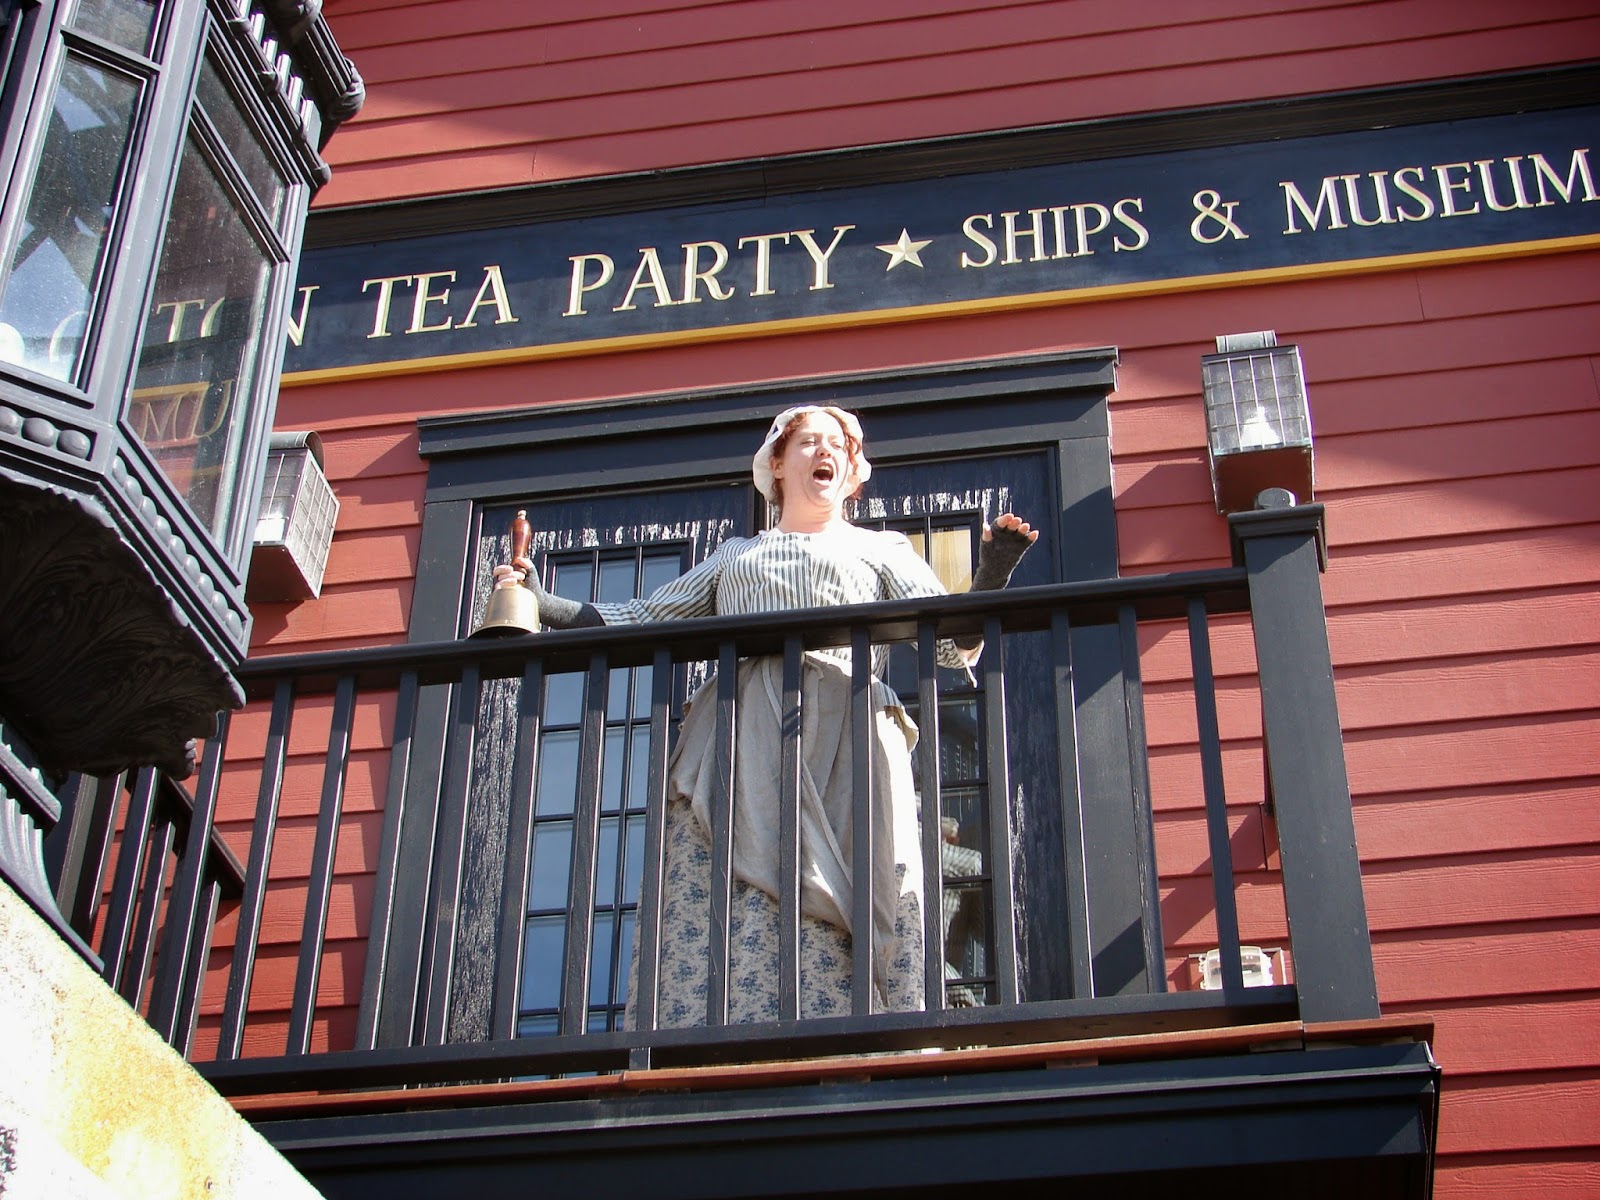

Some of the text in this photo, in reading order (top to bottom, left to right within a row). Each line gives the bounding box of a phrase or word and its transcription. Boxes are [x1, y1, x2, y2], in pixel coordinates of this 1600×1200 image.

[362, 265, 519, 338] TEA
[562, 225, 856, 317] PARTY
[960, 198, 1149, 268] SHIPS
[1191, 190, 1249, 243] &
[1279, 149, 1600, 234] MUSEUM
